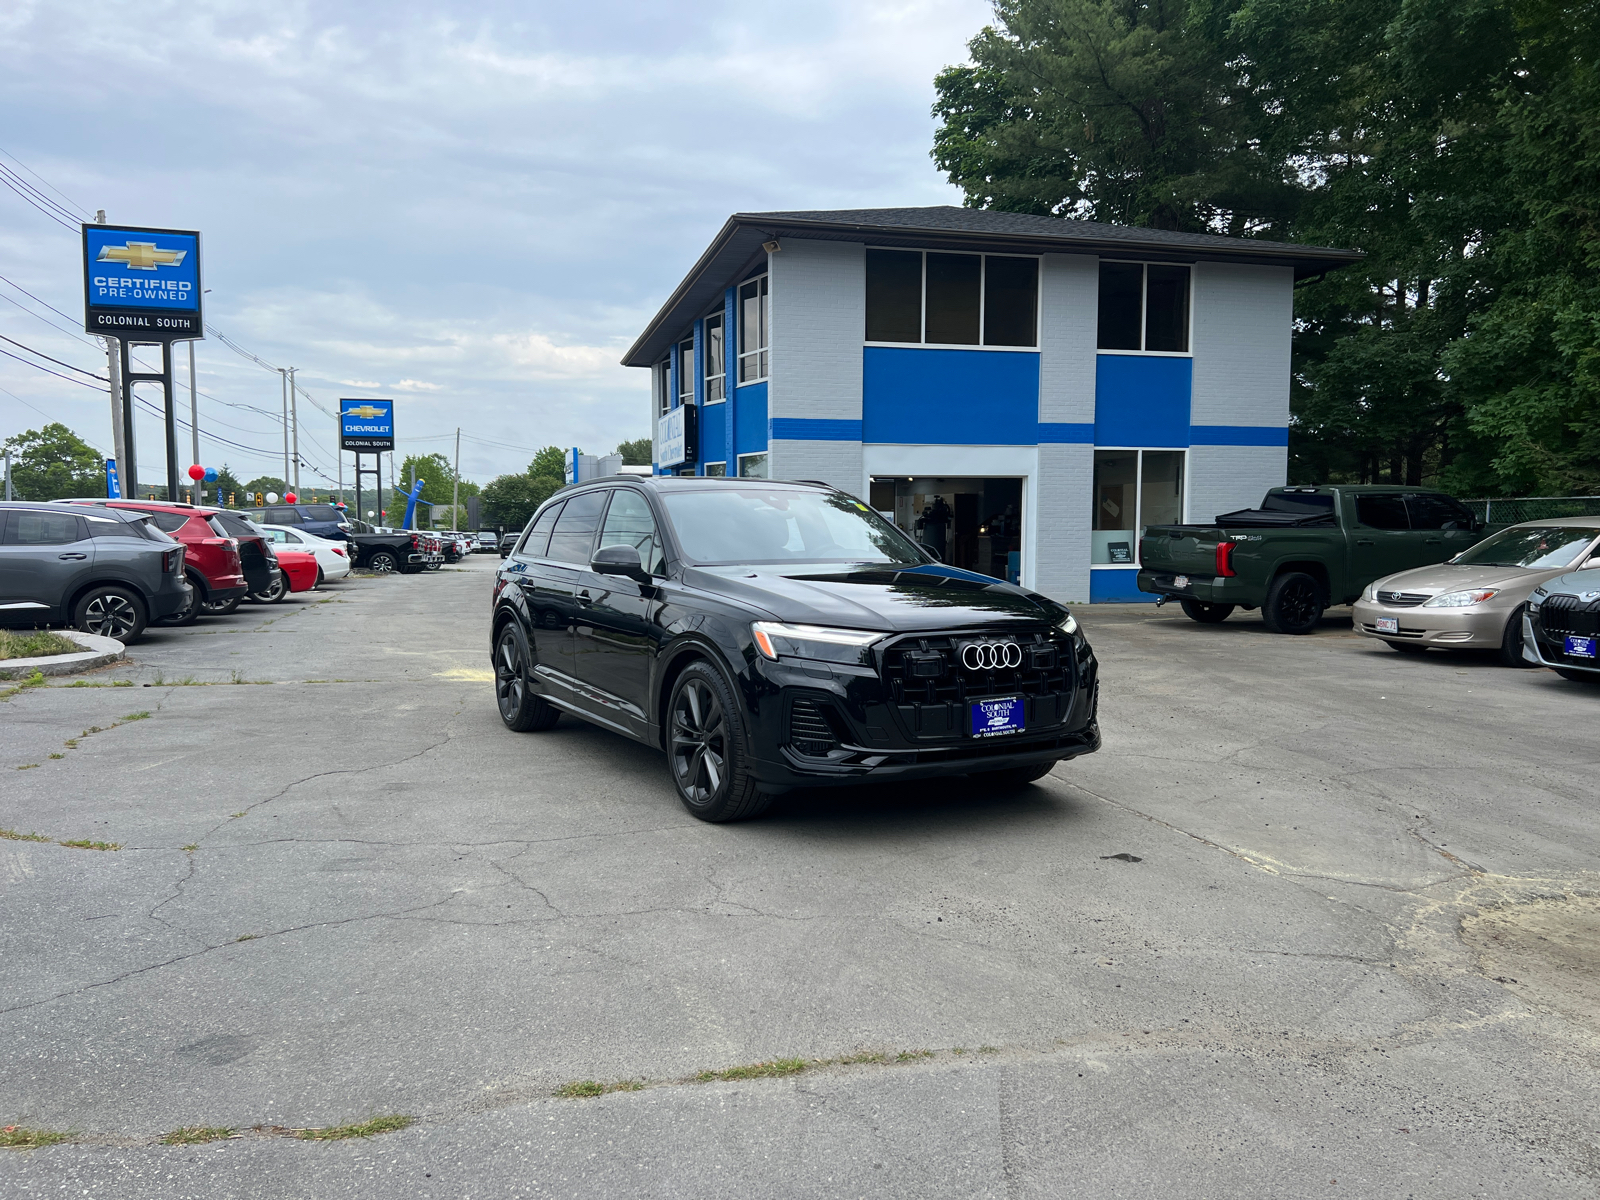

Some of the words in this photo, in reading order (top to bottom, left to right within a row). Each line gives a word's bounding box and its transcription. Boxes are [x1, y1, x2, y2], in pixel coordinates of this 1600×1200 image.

[94, 276, 192, 291] CERTIFIED
[99, 287, 187, 301] PRE-OWNED
[98, 315, 151, 327] COLONIAL
[157, 318, 191, 328] SOUTH
[981, 702, 1014, 712] COLONIAL
[987, 709, 1009, 718] SOUTH
